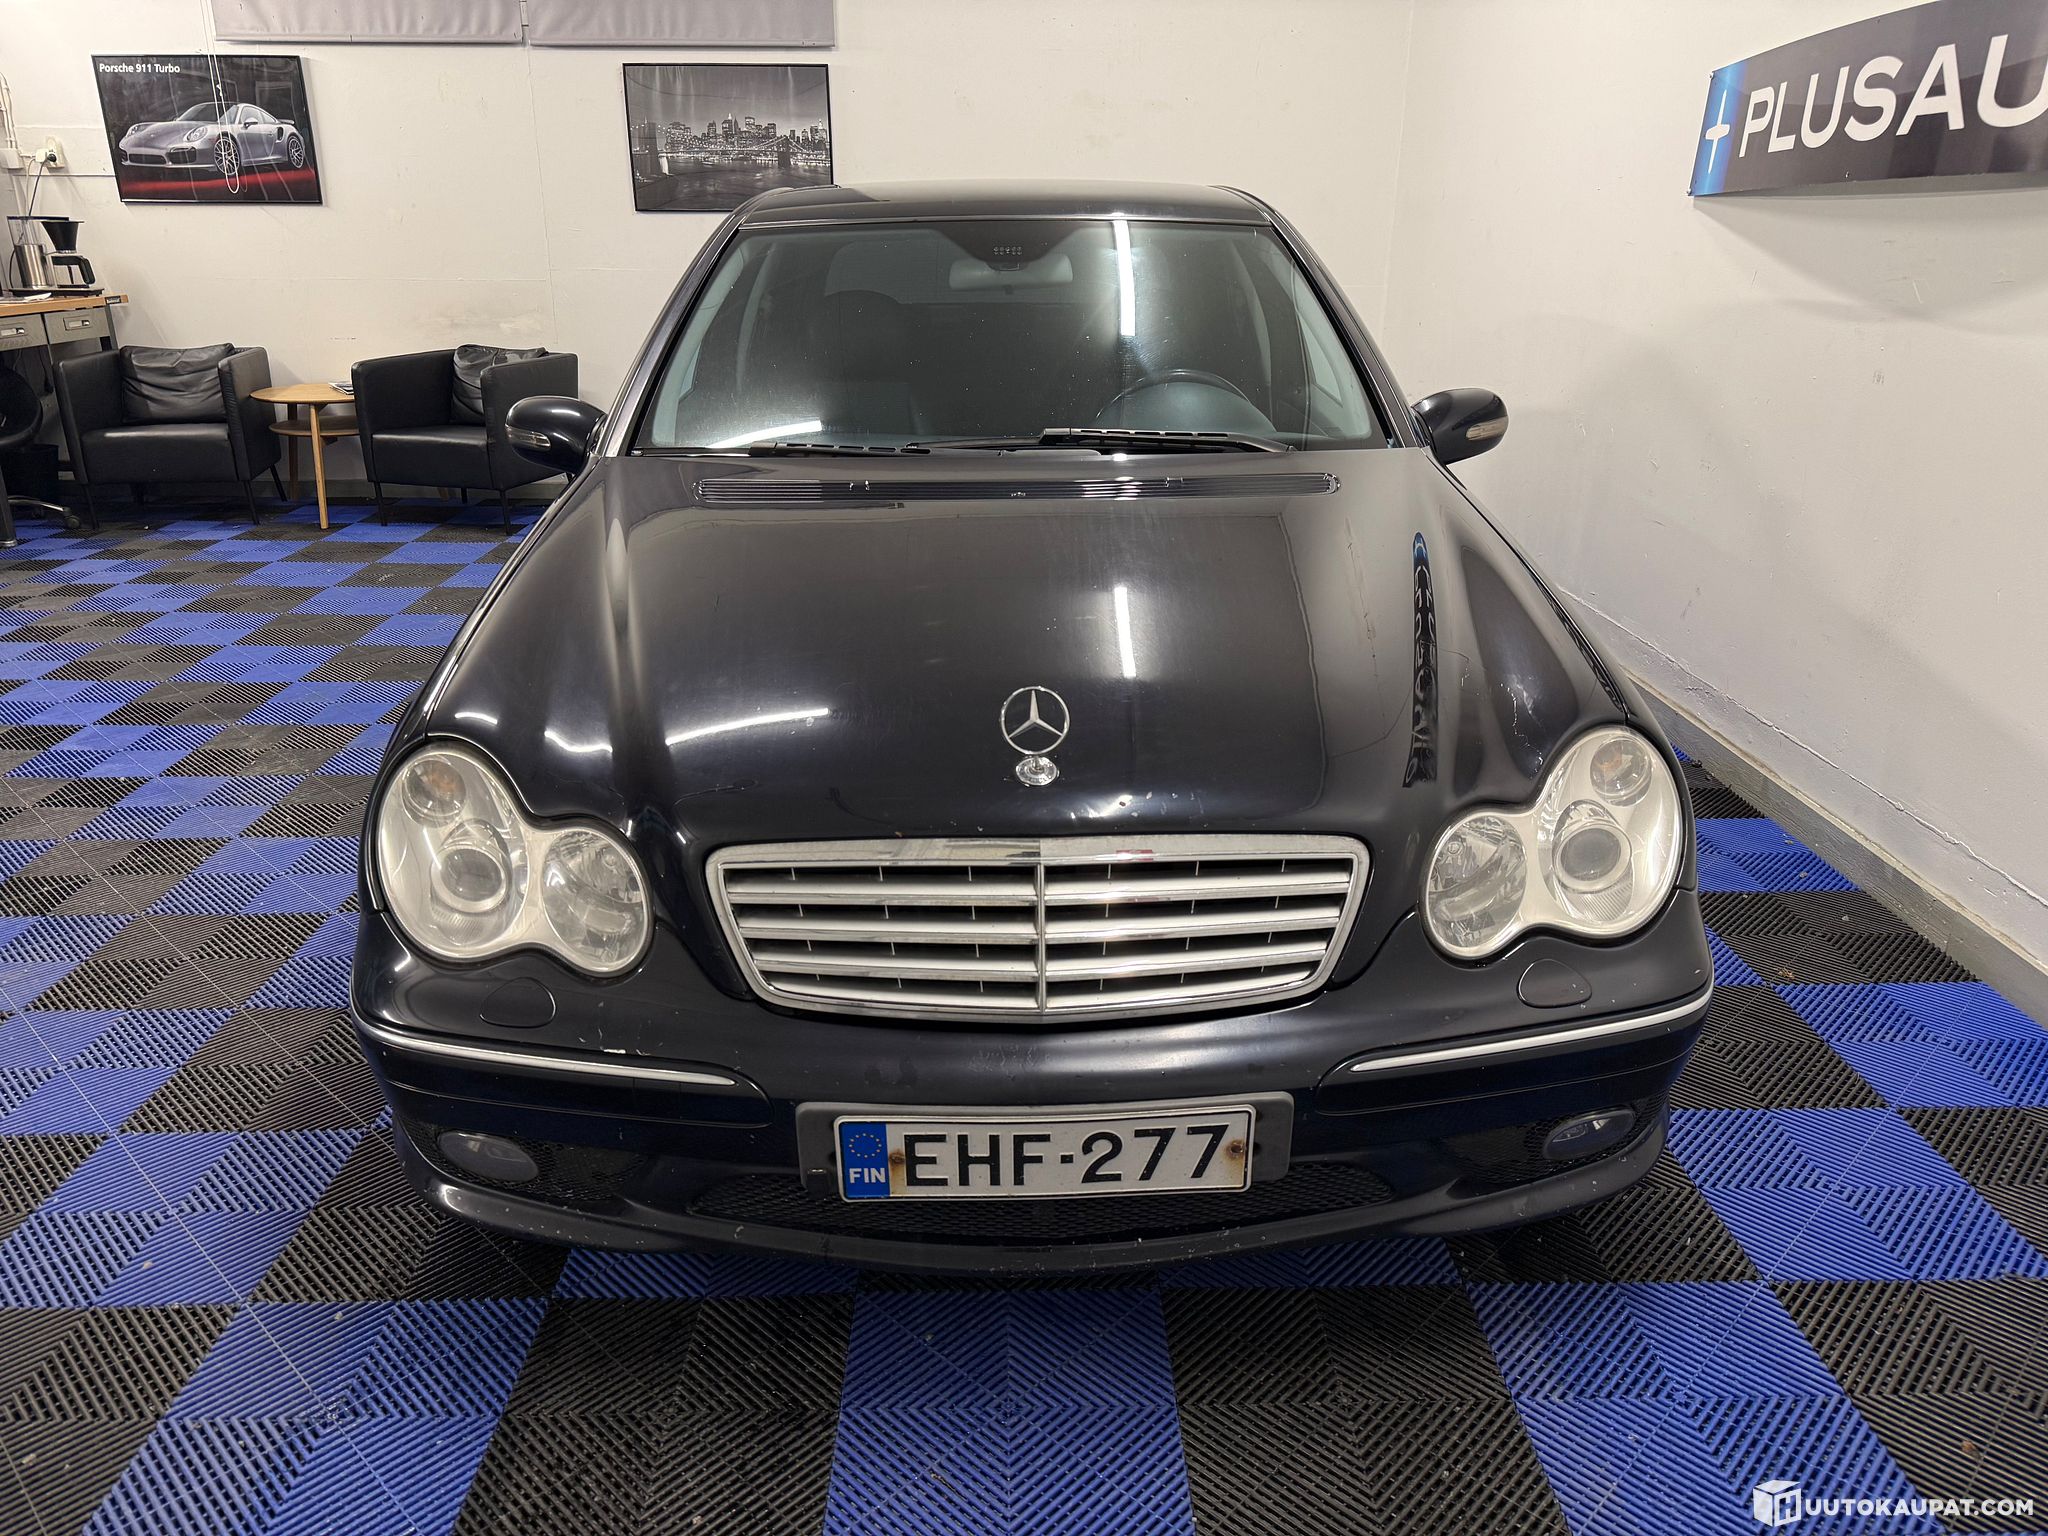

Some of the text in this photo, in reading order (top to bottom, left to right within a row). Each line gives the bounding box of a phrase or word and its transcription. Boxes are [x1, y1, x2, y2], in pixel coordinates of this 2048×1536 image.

[99, 63, 180, 73] Porsche 911 Turbo
[1739, 34, 2048, 158] PLUSAU
[903, 1123, 1230, 1187] EHF-277
[849, 1167, 886, 1184] FIN
